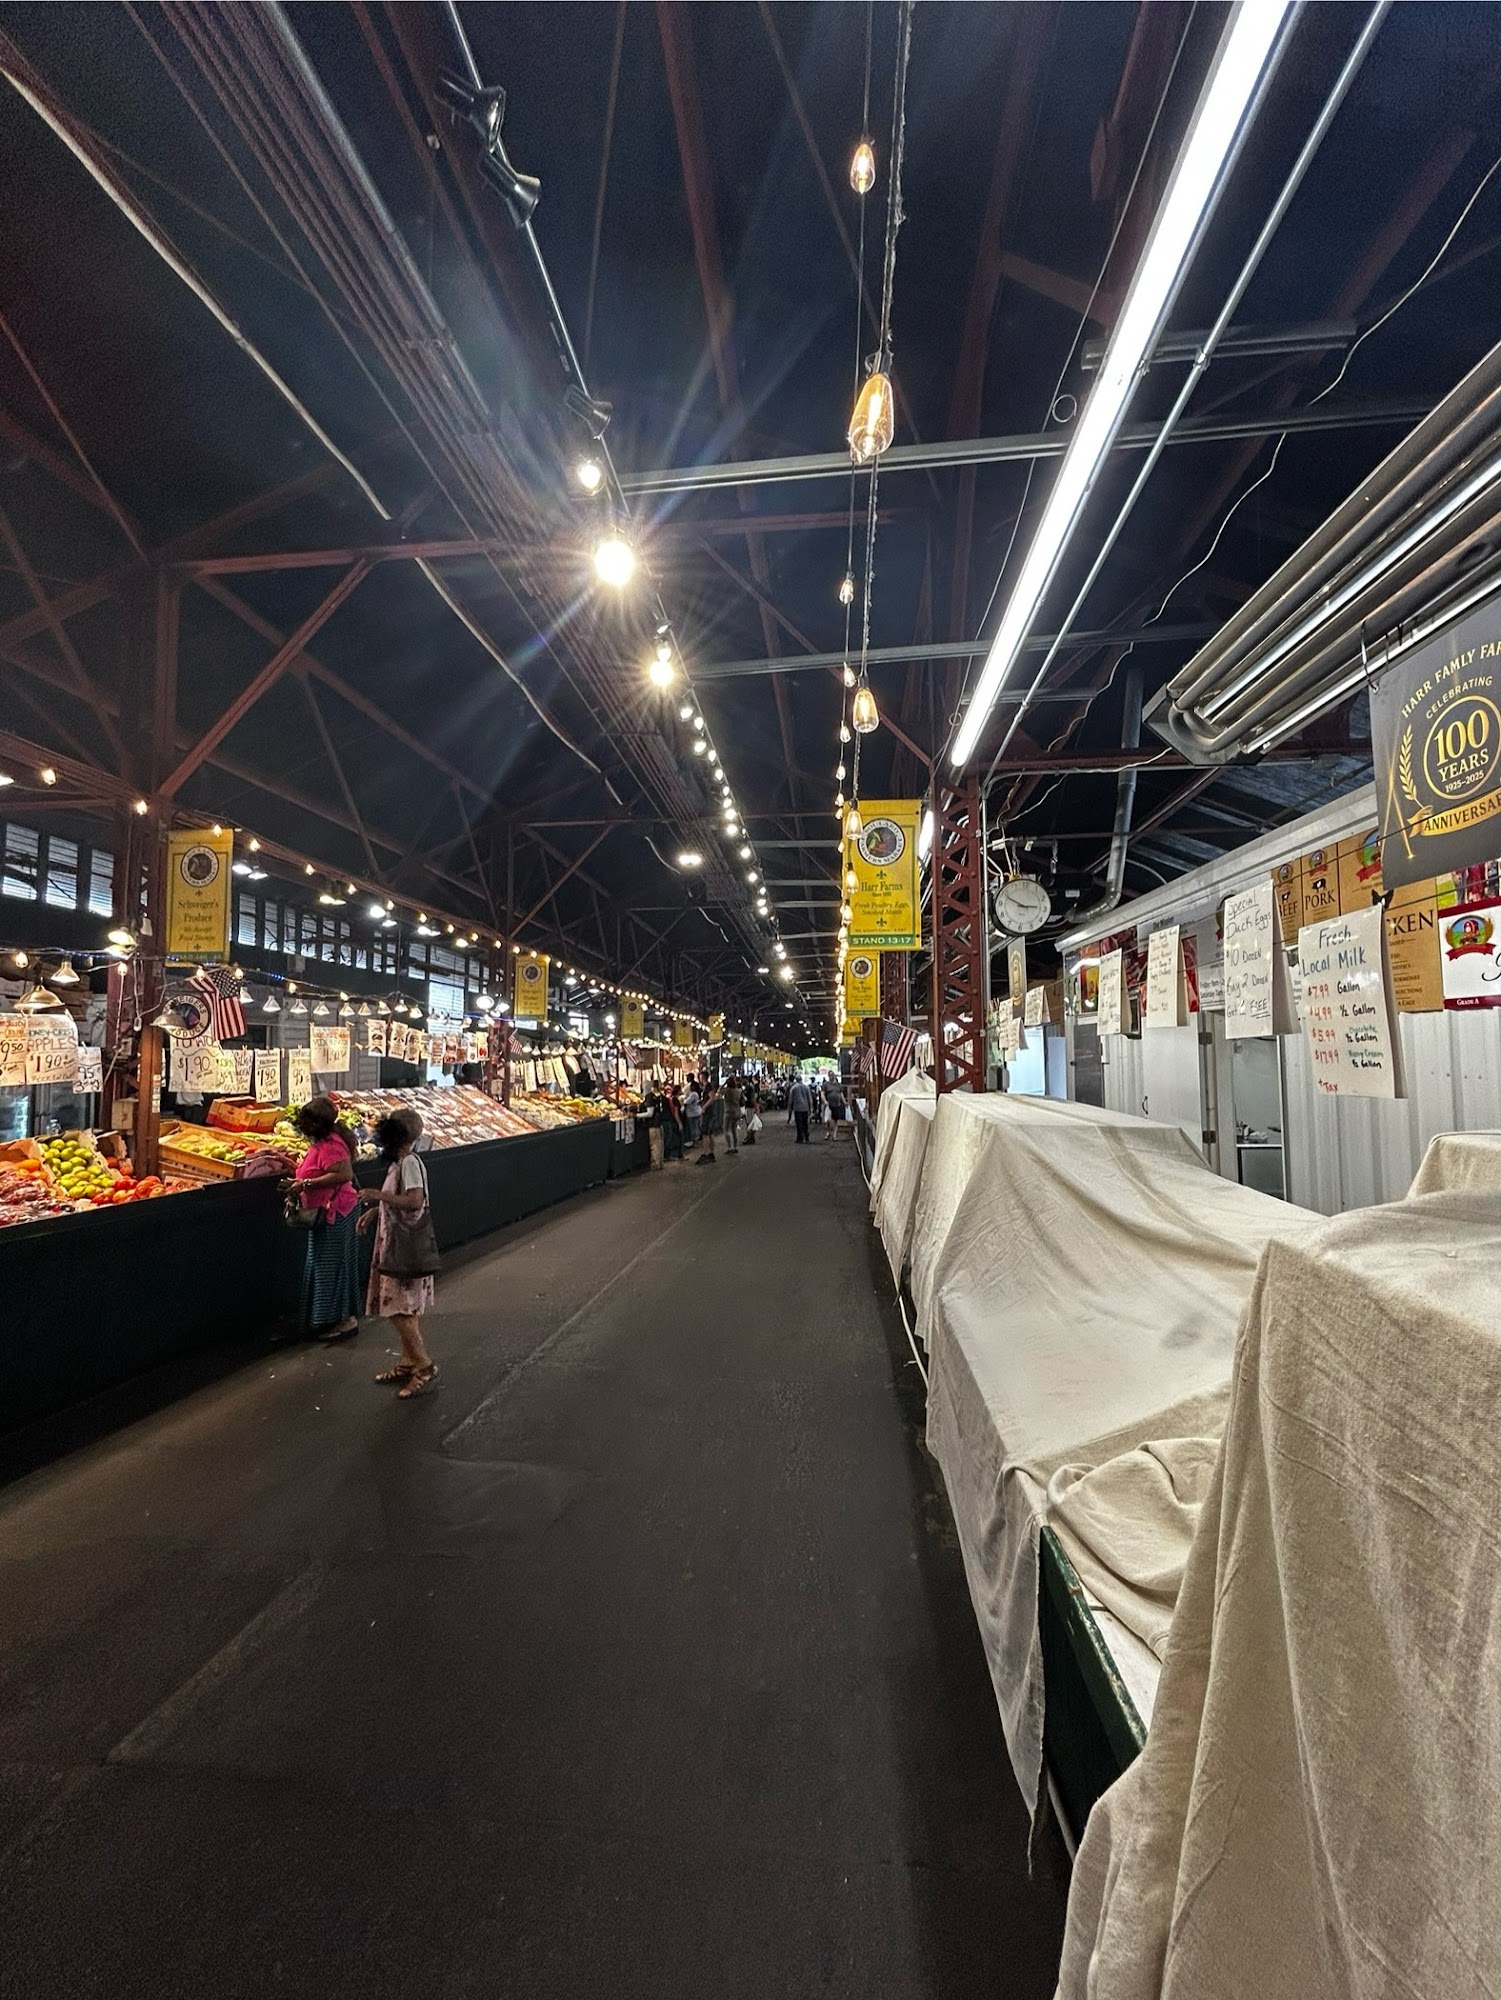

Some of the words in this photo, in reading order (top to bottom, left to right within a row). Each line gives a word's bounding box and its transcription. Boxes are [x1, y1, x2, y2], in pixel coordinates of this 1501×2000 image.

[1401, 680, 1433, 718] HARR
[1425, 675, 1493, 719] CELEBRATING
[1433, 709, 1489, 766] 100
[1438, 748, 1489, 783] YEARS
[861, 881, 879, 892] Harr
[880, 880, 903, 891] Farms
[1227, 889, 1257, 919] Special
[1304, 889, 1336, 911] PORK
[183, 912, 213, 922] Produce
[1226, 915, 1253, 940] Duck
[1255, 909, 1272, 931] Eggs
[852, 937, 885, 945] STAND
[1319, 924, 1351, 950] Fresh
[1301, 954, 1331, 978] Local
[1338, 946, 1367, 970] Milk
[1242, 973, 1249, 989] 2
[1307, 983, 1330, 999] $7.99
[1337, 980, 1361, 995] Gallon
[1227, 1004, 1238, 1018] Get
[1250, 998, 1268, 1013] FREE
[1472, 997, 1480, 1005] A
[1309, 1005, 1333, 1022] $4.99
[1352, 1002, 1376, 1017] Gallon
[170, 1023, 205, 1037] RODUCE
[1312, 1027, 1336, 1043] $5.99
[1354, 1032, 1379, 1043] Gallon
[27, 1037, 78, 1051] APPLES
[178, 1056, 211, 1081] $1.90
[1361, 1059, 1382, 1069] Gallon
